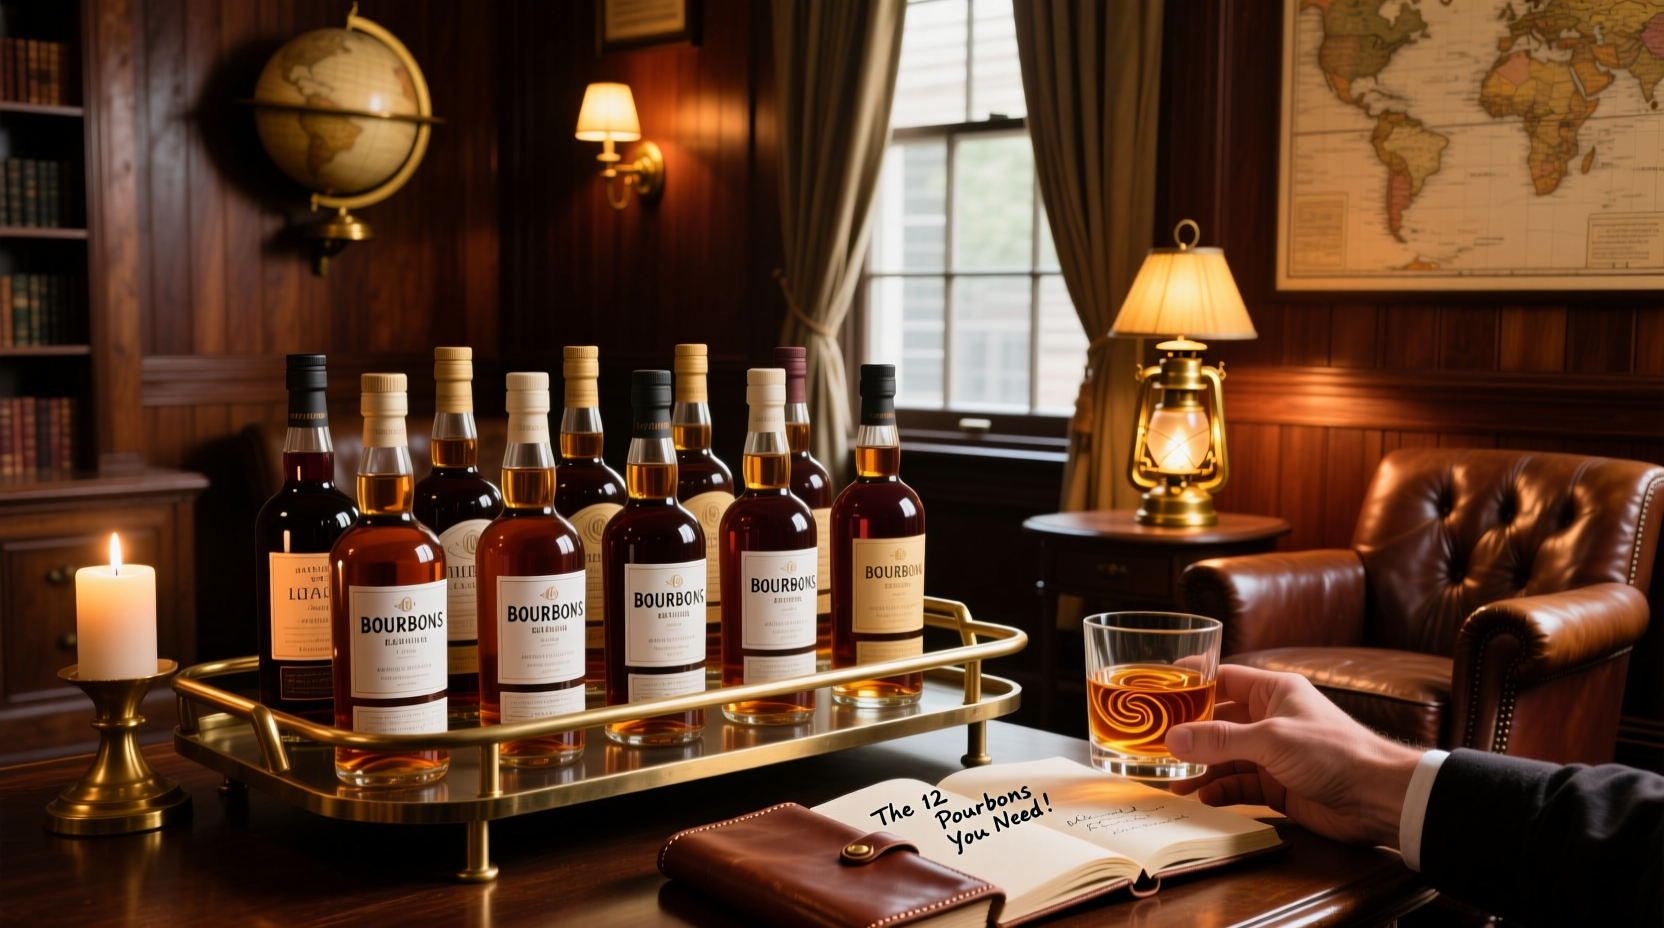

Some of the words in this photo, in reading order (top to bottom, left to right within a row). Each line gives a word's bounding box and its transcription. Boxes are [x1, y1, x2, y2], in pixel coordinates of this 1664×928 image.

[751, 574, 816, 594] BOURBONS
[634, 588, 704, 608] BOURBONS
[361, 611, 443, 633] BOURBONS
[507, 600, 584, 622] BOURBONS
[870, 803, 914, 826] The
[921, 789, 948, 810] 12
[934, 785, 1032, 830] Pourbons
[946, 829, 990, 855] You
[992, 792, 1053, 833] Need!
